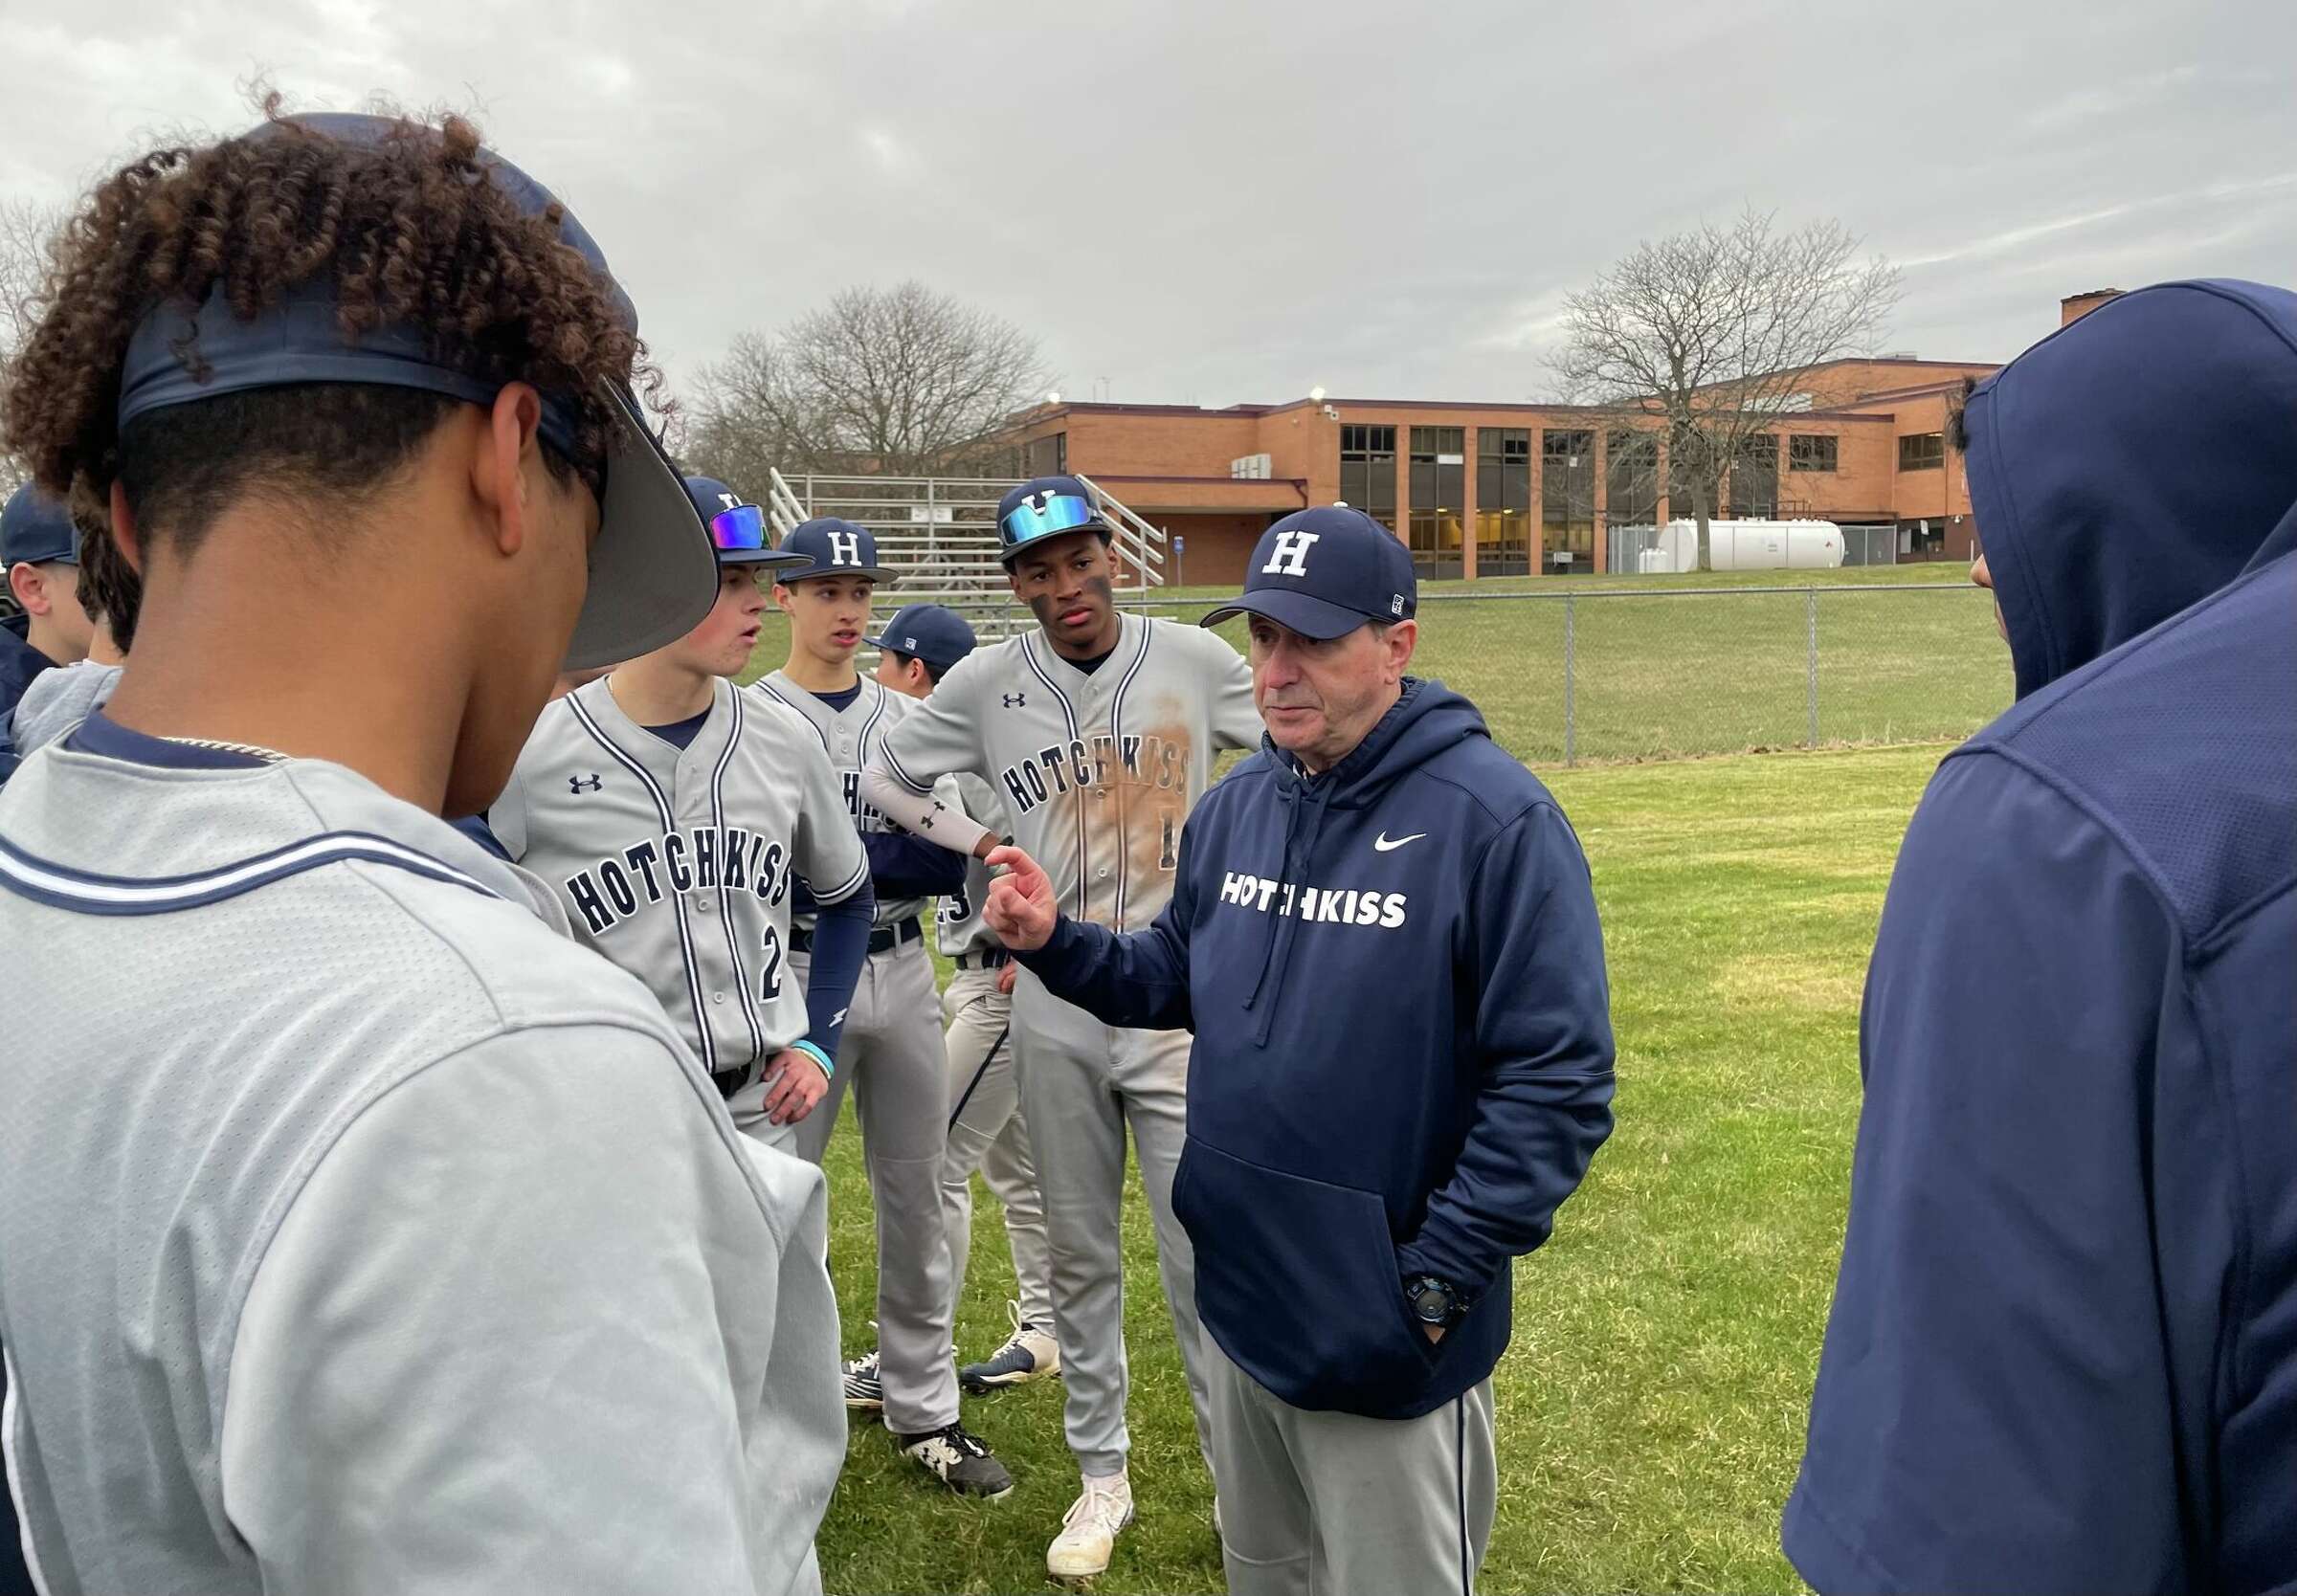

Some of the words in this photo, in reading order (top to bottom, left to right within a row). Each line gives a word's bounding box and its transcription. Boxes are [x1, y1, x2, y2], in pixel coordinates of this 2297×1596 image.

[827, 531, 862, 566] H
[1262, 530, 1320, 577] H
[1220, 872, 1407, 929] HOTHKISS
[759, 924, 782, 1004] 2
